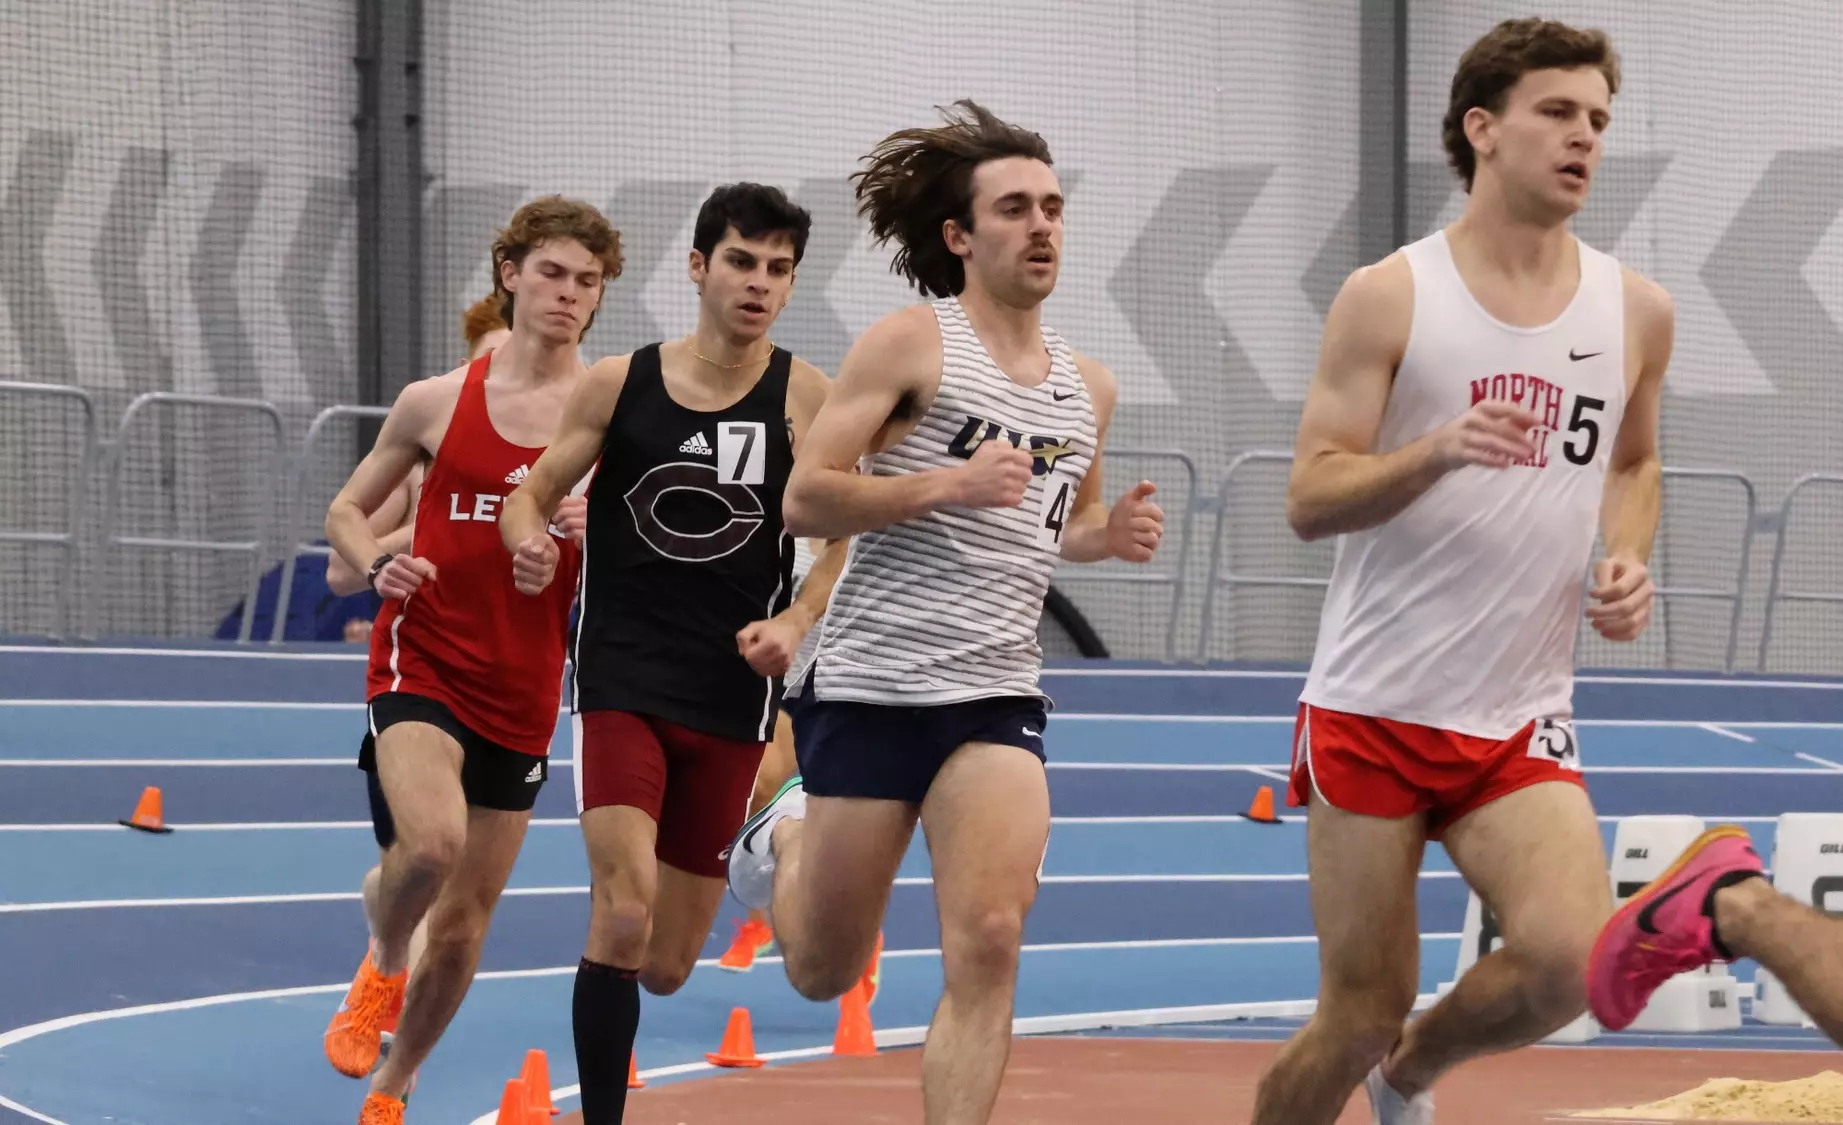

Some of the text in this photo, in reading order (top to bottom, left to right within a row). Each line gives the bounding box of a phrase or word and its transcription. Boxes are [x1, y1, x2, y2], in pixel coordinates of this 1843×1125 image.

[679, 443, 713, 456] adidas
[728, 426, 756, 481] 7
[1563, 394, 1605, 465] 5
[1045, 482, 1069, 543] 4
